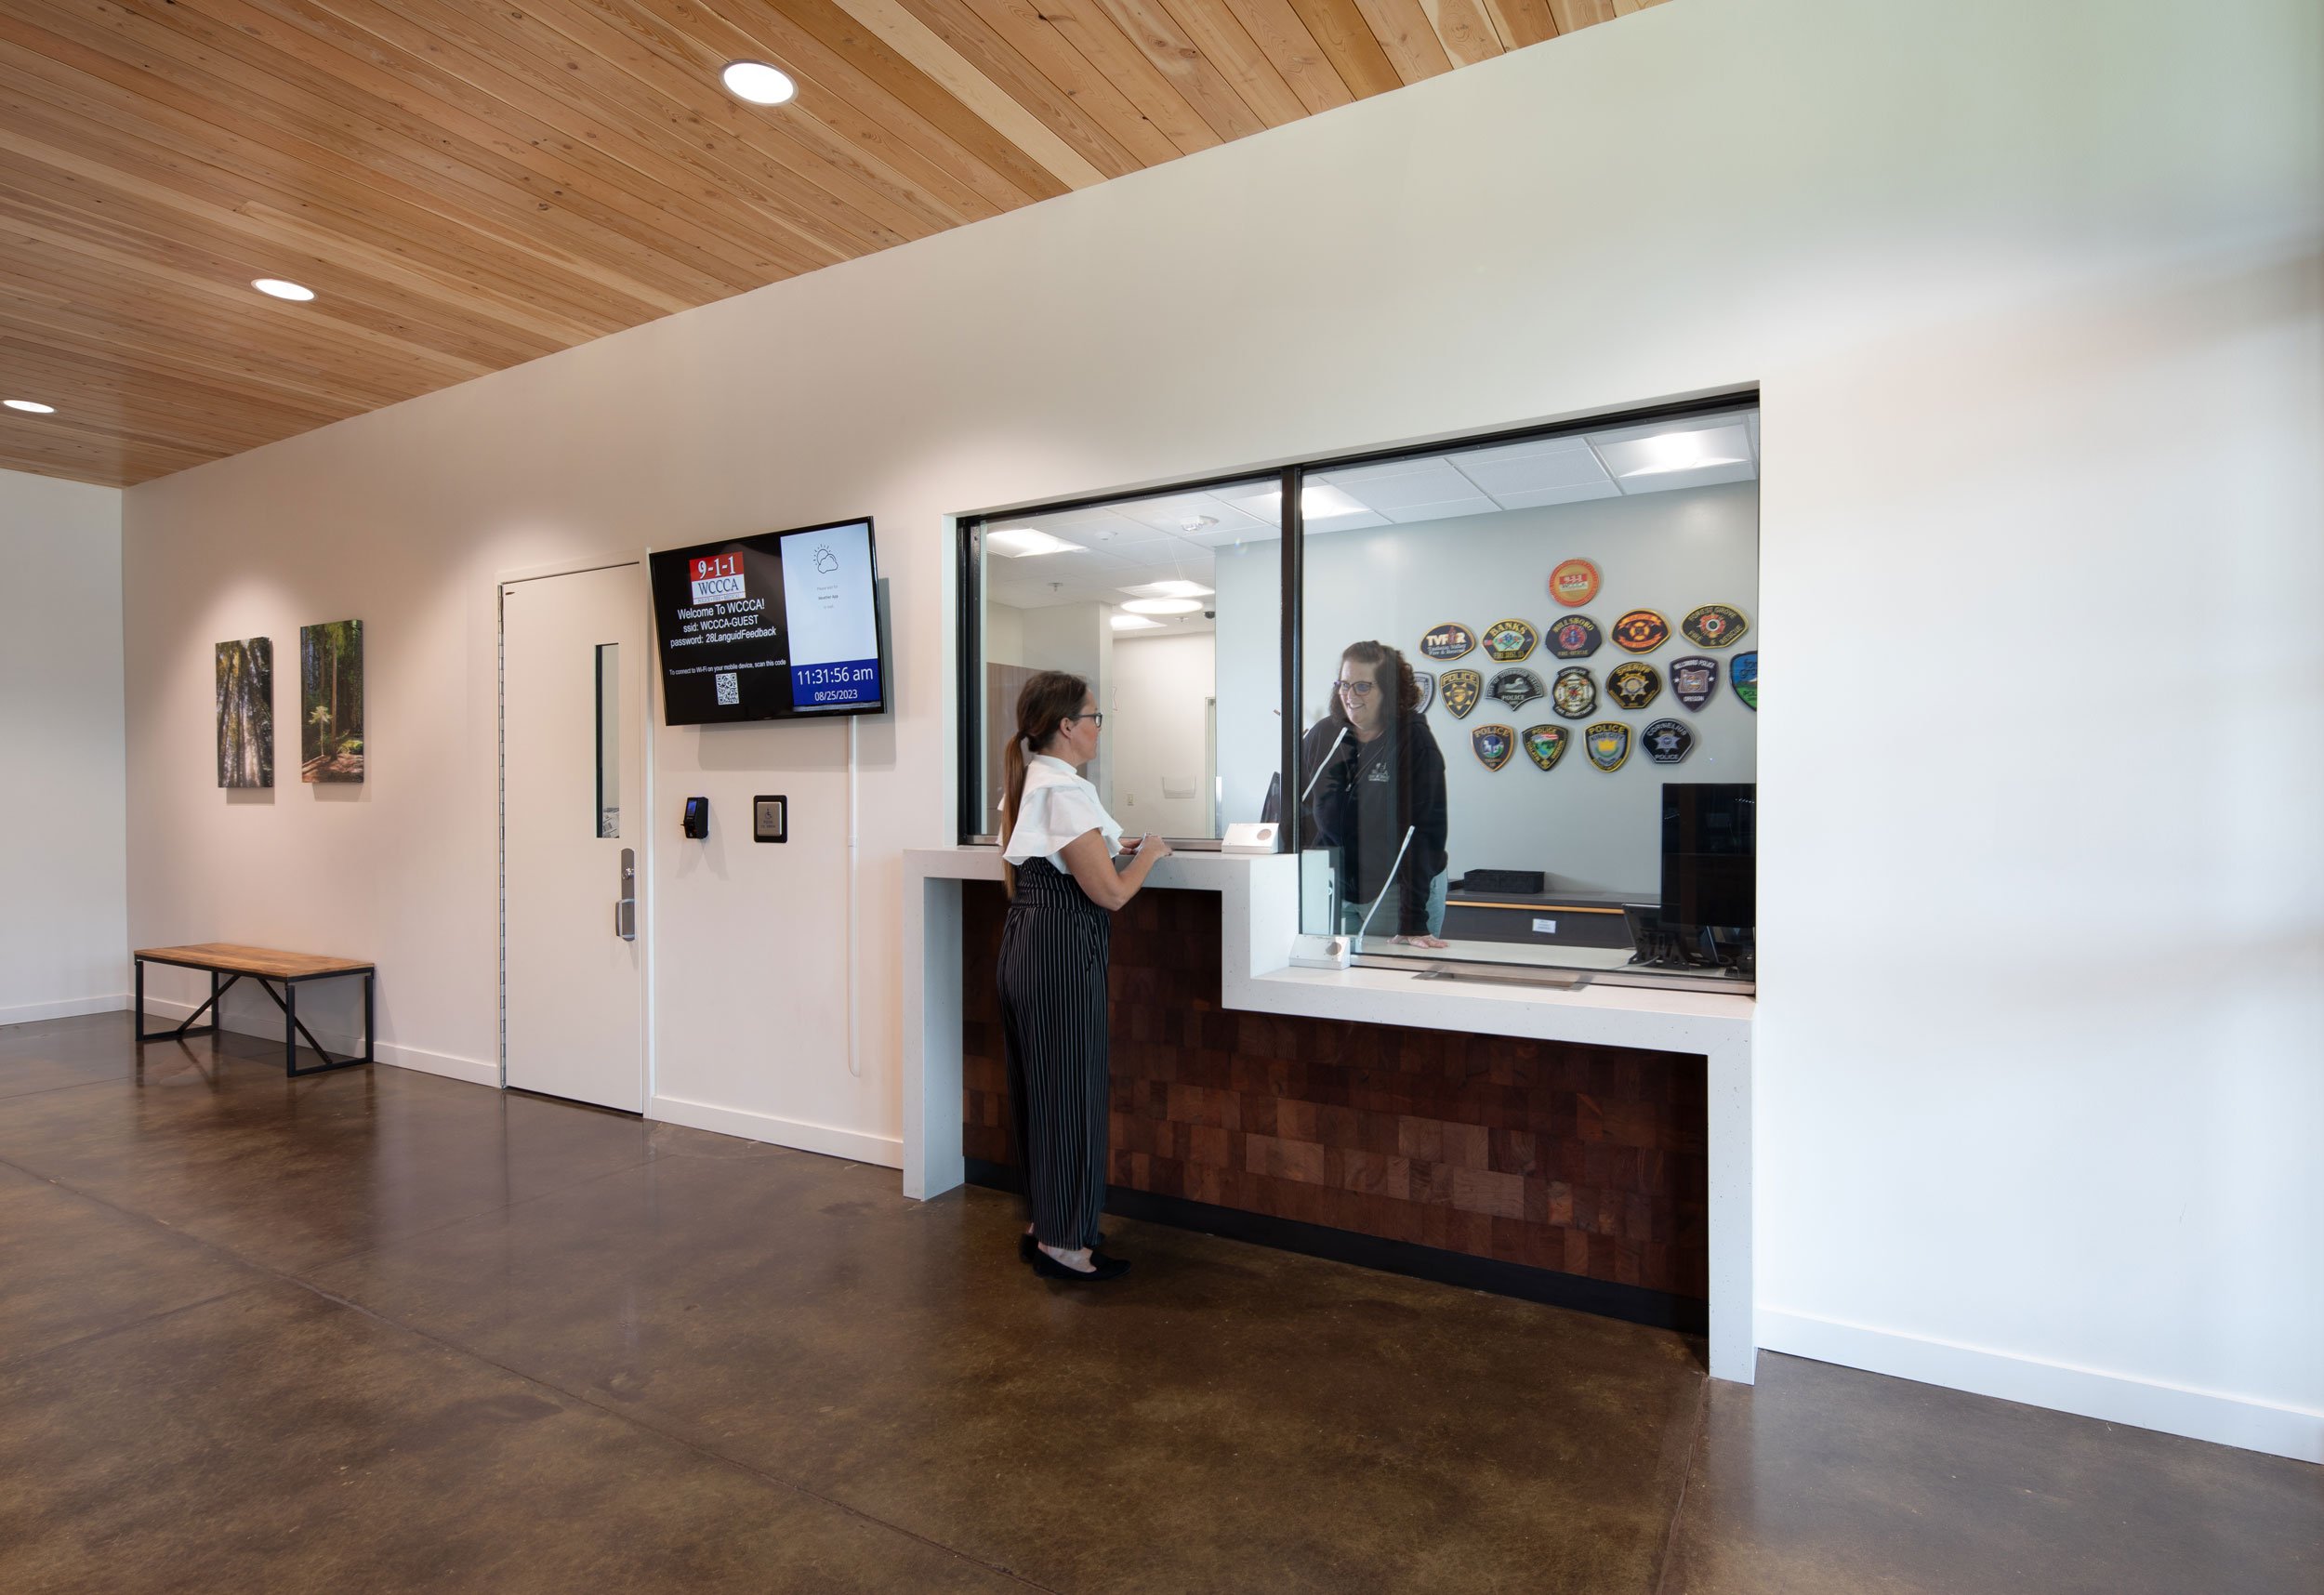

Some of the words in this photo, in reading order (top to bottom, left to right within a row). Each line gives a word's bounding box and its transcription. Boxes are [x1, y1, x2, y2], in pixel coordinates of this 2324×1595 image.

[698, 555, 736, 579] 9-1-1
[698, 578, 739, 596] WCCCA
[678, 607, 714, 620] Welcome
[715, 604, 725, 615] To
[727, 599, 765, 613] WCCCA!
[683, 624, 699, 633] ssid:
[700, 614, 759, 630] WCCCA-GUEST
[1489, 622, 1528, 637] BANKS
[670, 635, 704, 649] password:
[706, 626, 776, 643] 28LanguidFeedback
[798, 666, 850, 685] 11:31:56
[852, 667, 874, 681] am
[1443, 672, 1477, 686] POLICE
[814, 689, 858, 701] 08/25/2023
[1474, 727, 1511, 738] POLICE
[1587, 724, 1625, 735] POLICE
[1646, 722, 1687, 736] CORNELIUS
